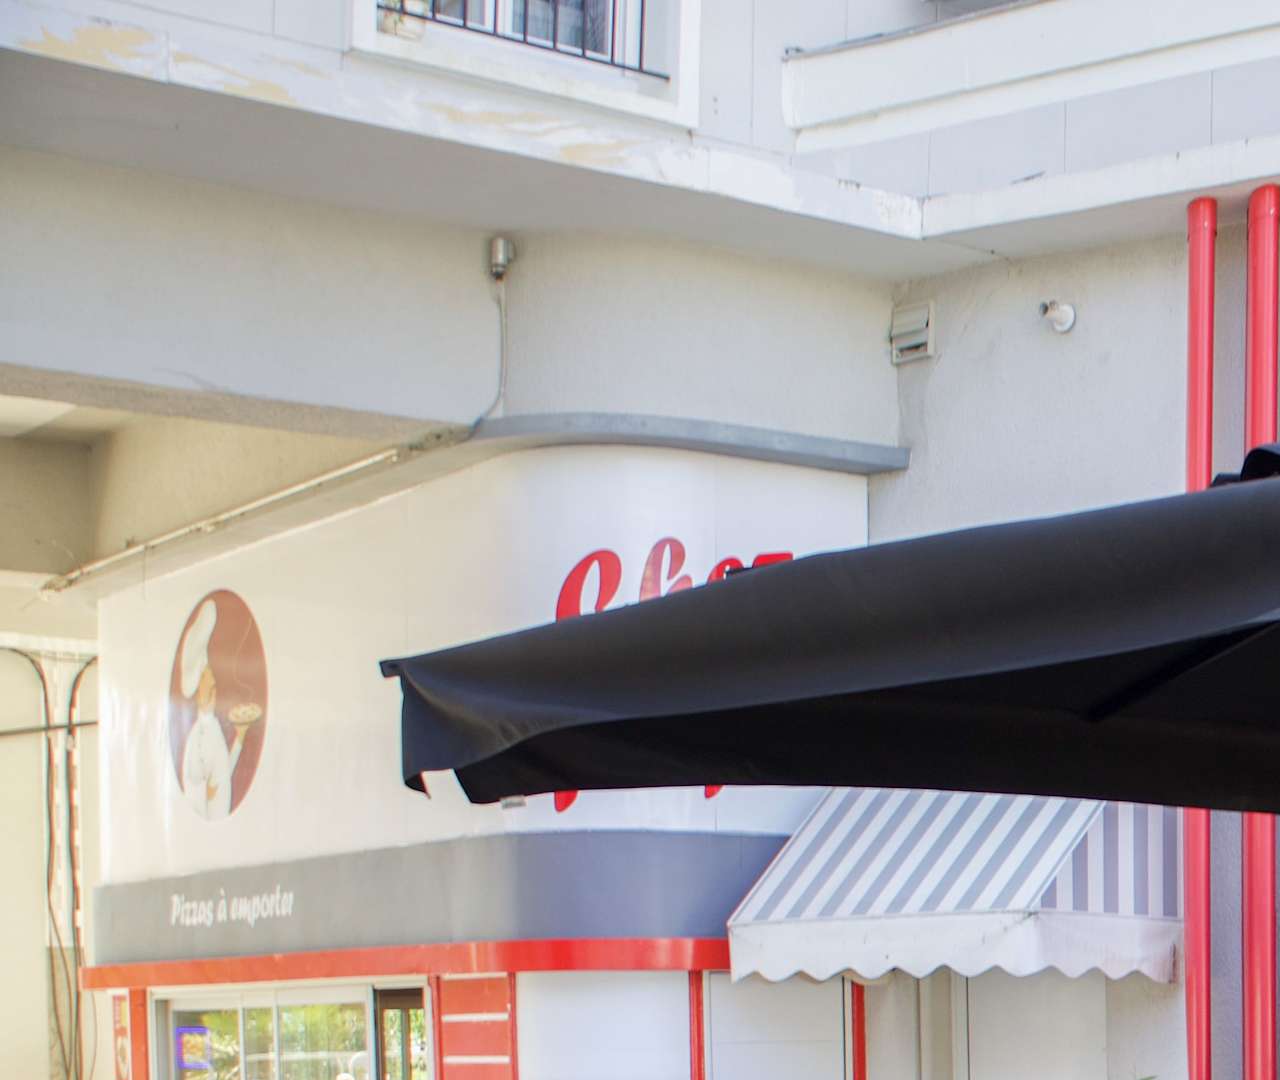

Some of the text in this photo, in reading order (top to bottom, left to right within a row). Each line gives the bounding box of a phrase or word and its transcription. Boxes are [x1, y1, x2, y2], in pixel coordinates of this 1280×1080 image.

[171, 884, 294, 928] Pizzas à emporter
